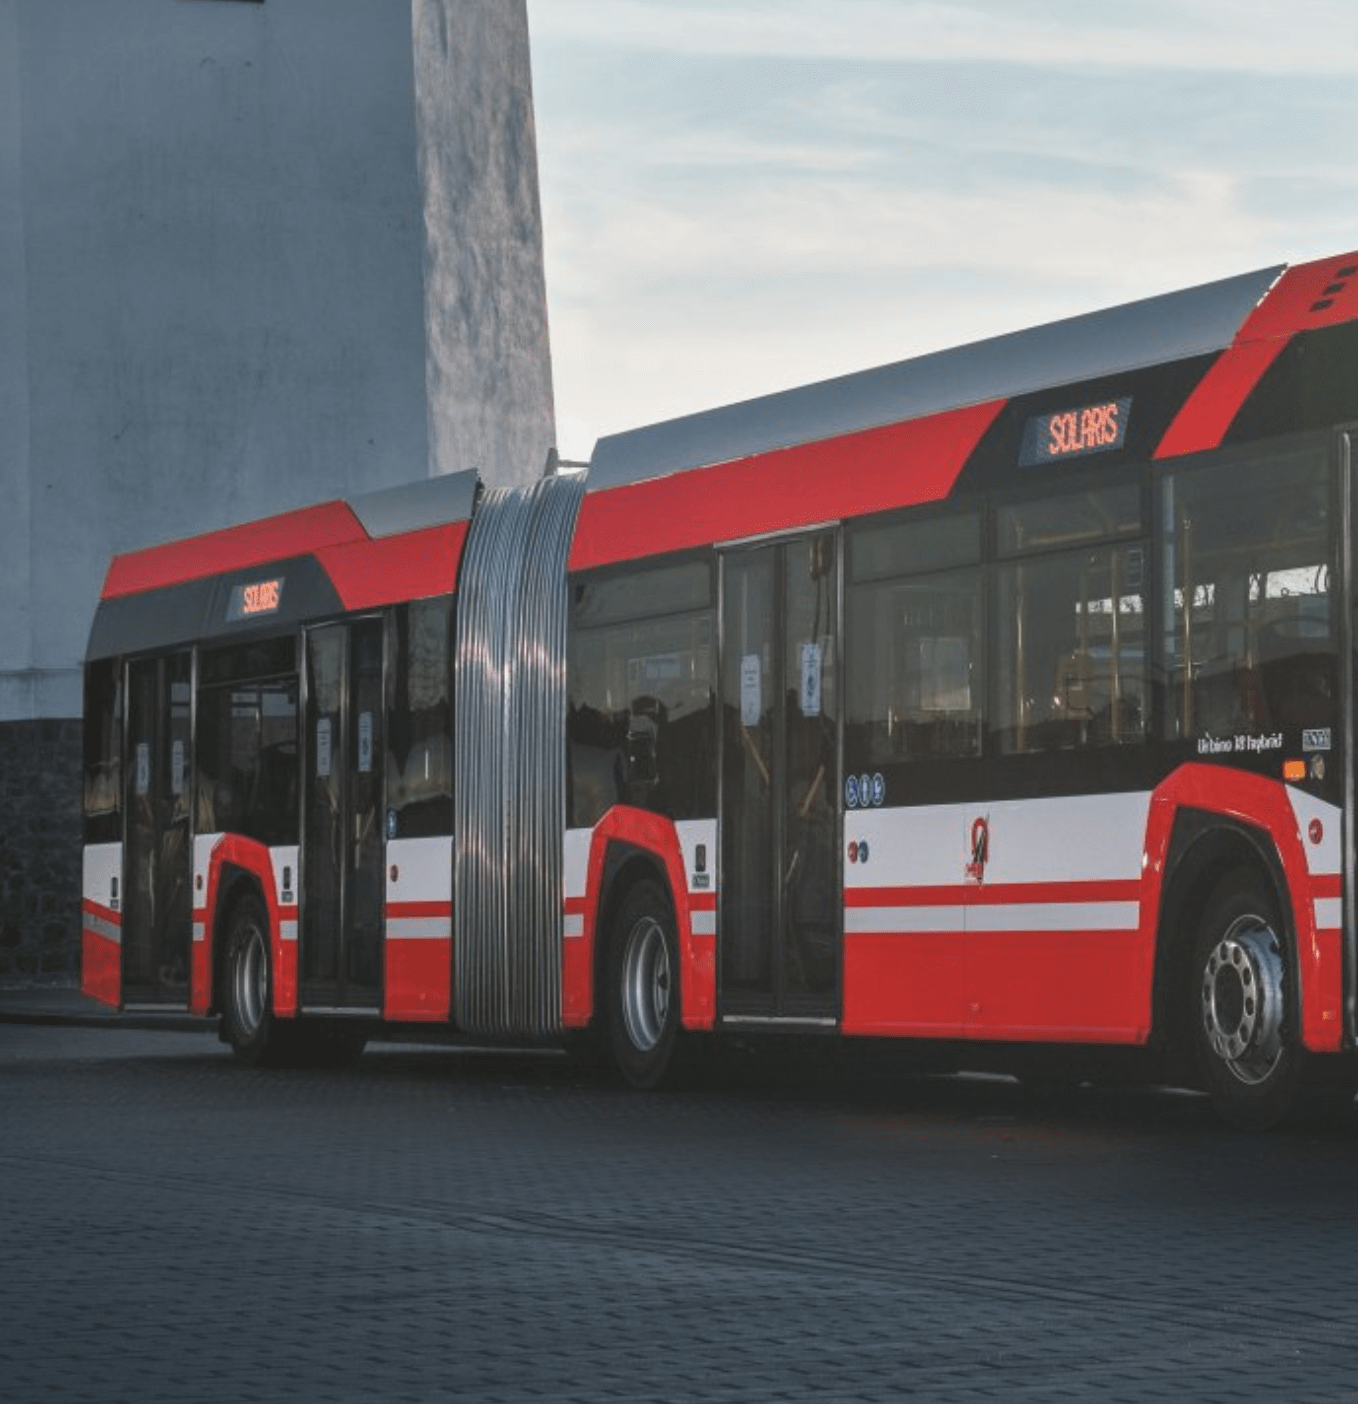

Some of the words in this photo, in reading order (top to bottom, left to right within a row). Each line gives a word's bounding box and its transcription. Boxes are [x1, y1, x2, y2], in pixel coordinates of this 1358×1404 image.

[1049, 403, 1118, 455] SOLARIS
[1198, 731, 1232, 754] Urbino
[1234, 735, 1246, 751] 18
[1247, 732, 1283, 754] hybrid
